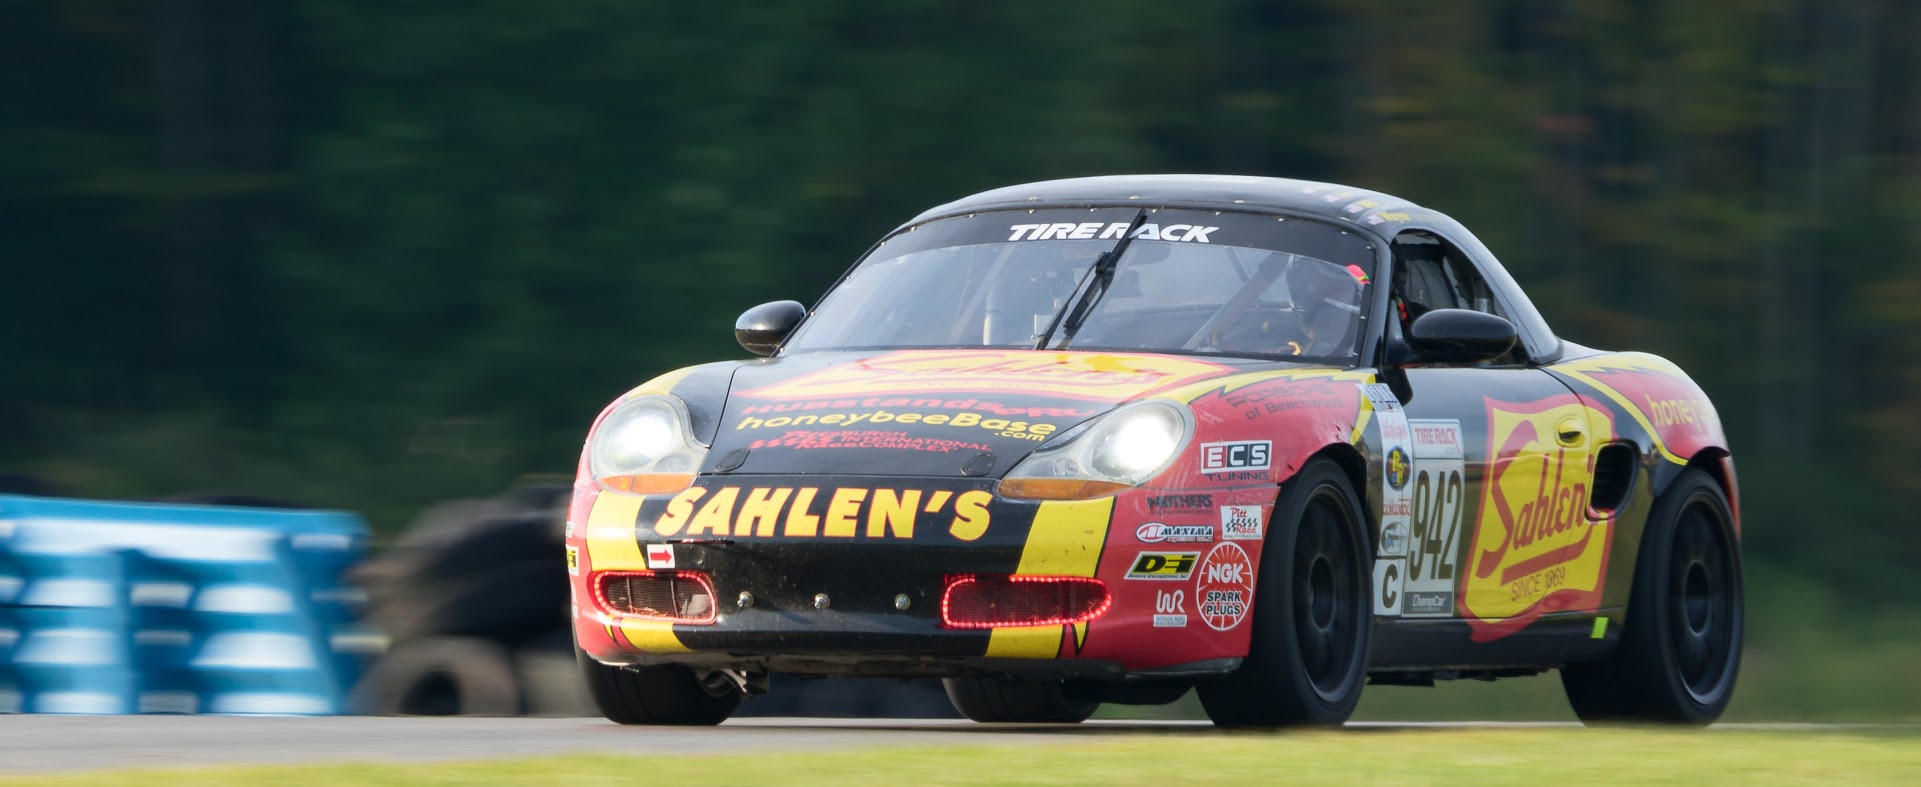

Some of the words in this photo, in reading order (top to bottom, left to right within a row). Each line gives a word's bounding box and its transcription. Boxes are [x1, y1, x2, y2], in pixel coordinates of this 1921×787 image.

[1008, 222, 1104, 241] TIRE
[1099, 222, 1219, 243] RACK
[1245, 406, 1260, 420] of
[736, 410, 1057, 435] honeybeeBase
[840, 434, 992, 452] INTERNATIONAL
[994, 430, 1046, 442] .com
[1415, 427, 1434, 445] TIRE
[1434, 427, 1459, 450] RACK
[1206, 443, 1268, 469] ECS
[1205, 471, 1269, 482] TUNING
[1147, 493, 1213, 510] MOTHERS
[653, 486, 993, 541] SAHLEN'S
[1230, 507, 1247, 518] Pitt
[1160, 526, 1213, 536] MAXIMA
[1235, 523, 1257, 534] Race
[1410, 469, 1462, 581] 942
[1207, 562, 1243, 584] NGK
[1382, 563, 1398, 609] C
[1511, 570, 1541, 602] SINCE
[1544, 566, 1566, 589] 1869
[1206, 590, 1242, 603] SPARK
[1205, 604, 1241, 616] PLUGS
